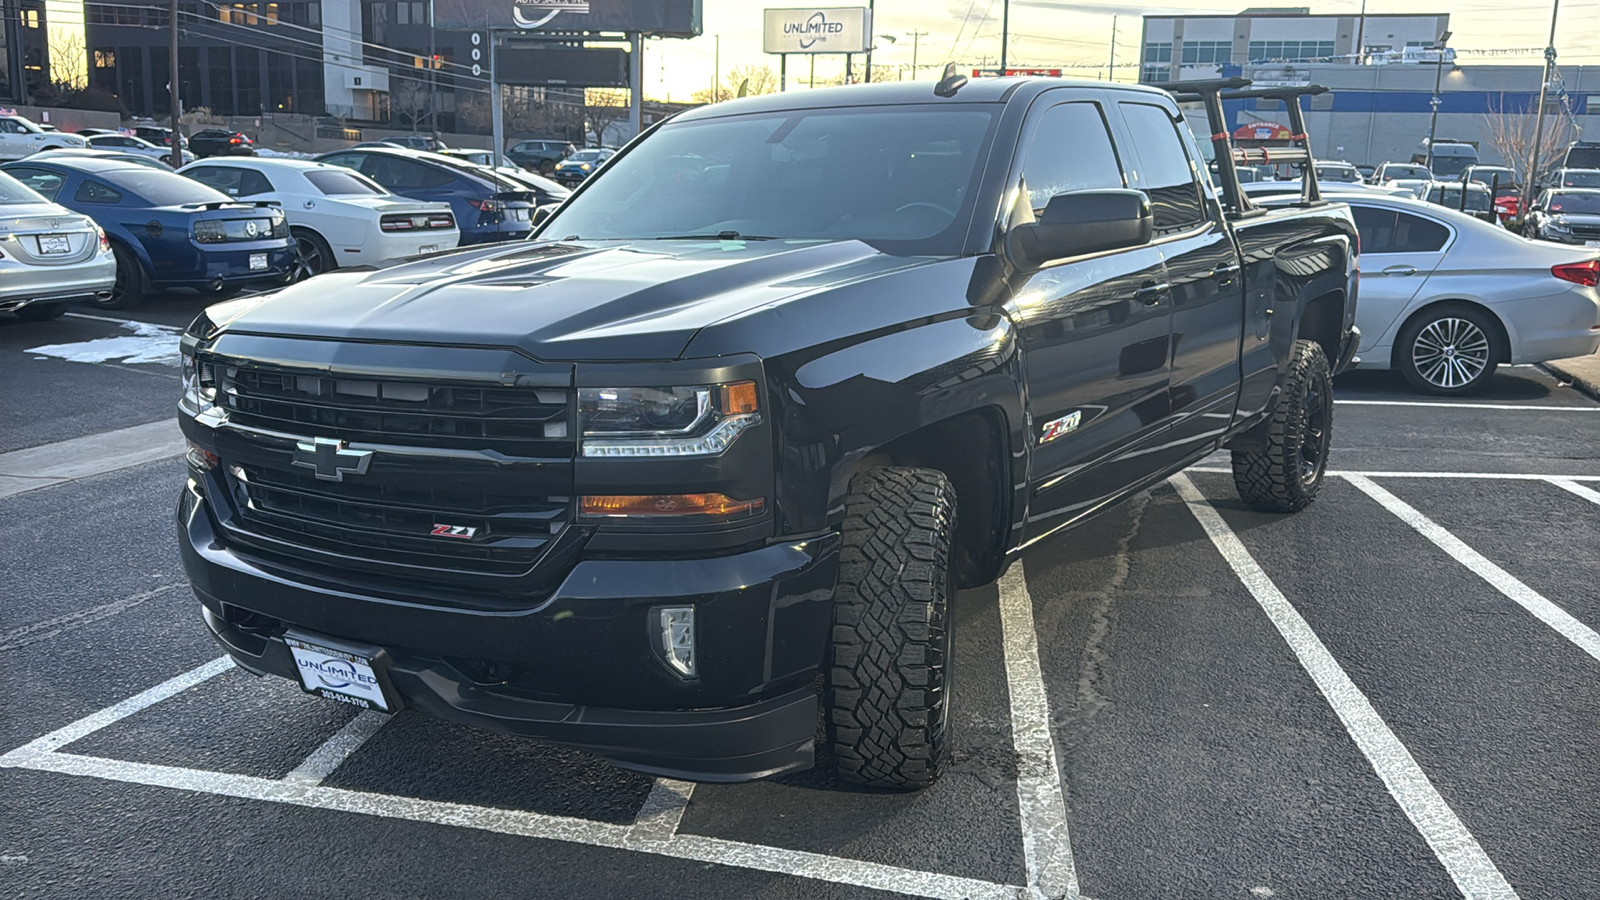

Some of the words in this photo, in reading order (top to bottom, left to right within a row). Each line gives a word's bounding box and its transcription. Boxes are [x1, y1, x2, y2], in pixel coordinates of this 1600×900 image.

[784, 23, 843, 33] UNLIMITED
[1248, 122, 1280, 130] ENTRANCE
[431, 524, 477, 539] Z71
[298, 658, 378, 685] UNLIMITED
